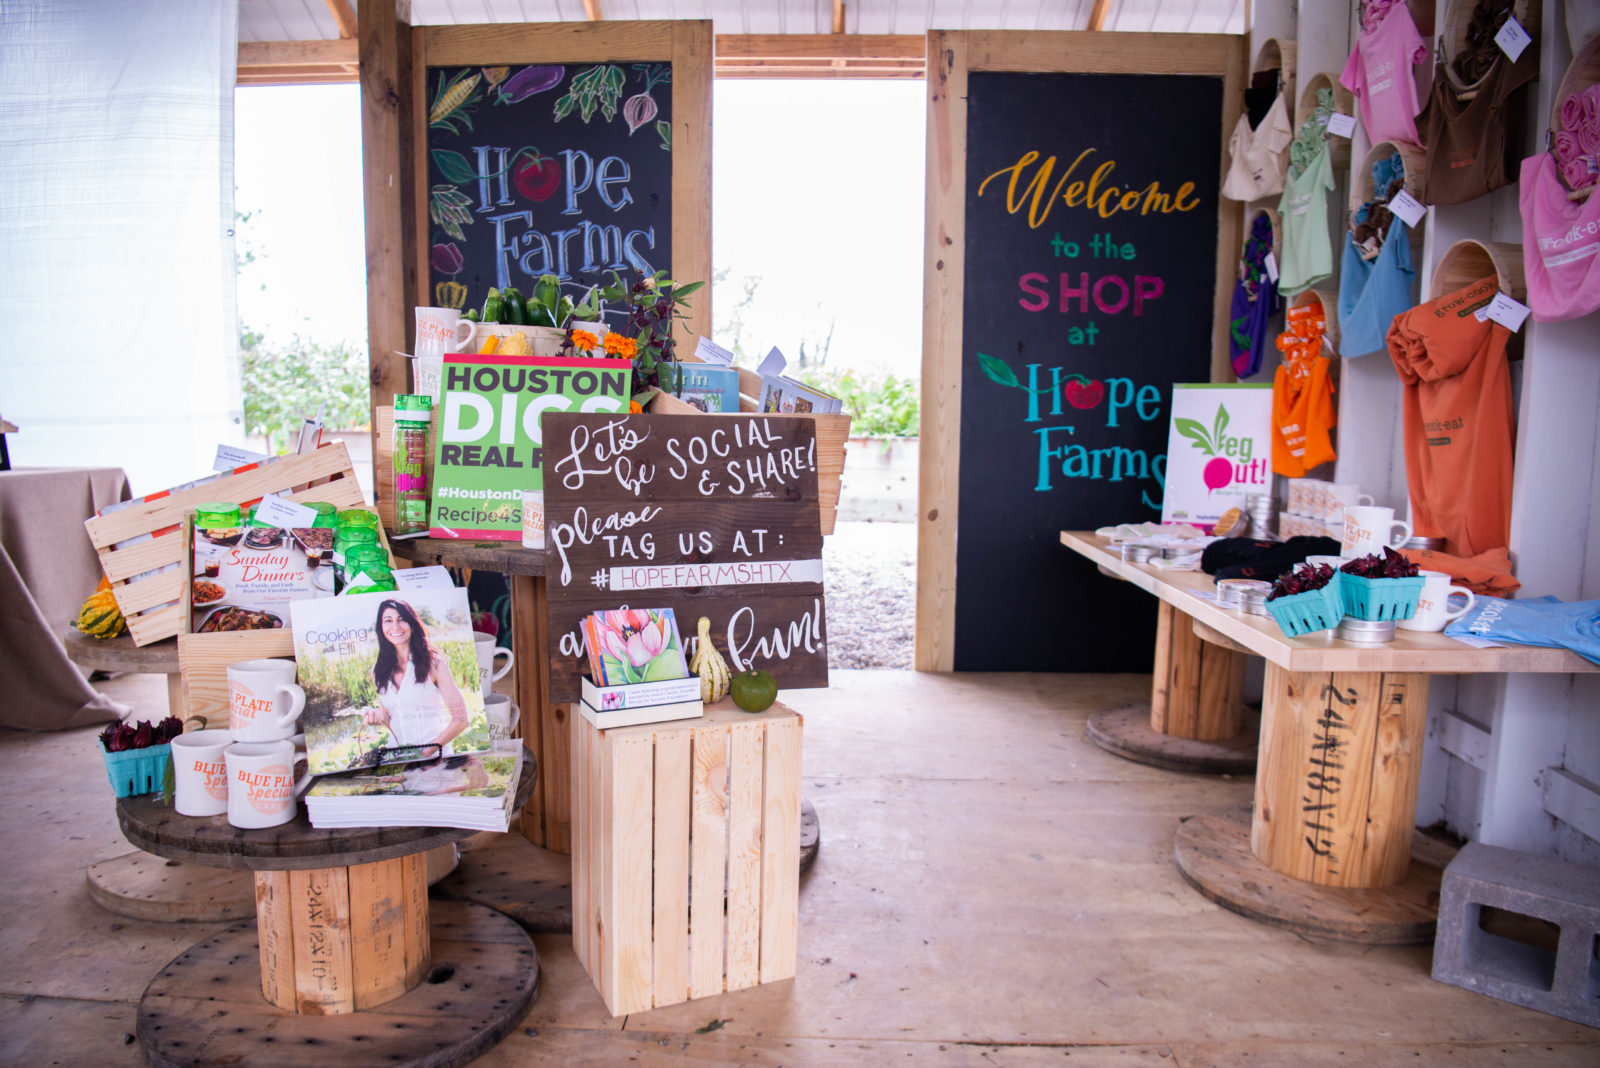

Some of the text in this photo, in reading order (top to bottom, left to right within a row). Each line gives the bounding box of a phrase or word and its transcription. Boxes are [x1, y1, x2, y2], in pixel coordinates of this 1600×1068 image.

[978, 148, 1200, 229] Welcome
[486, 210, 657, 300] Farms
[1051, 233, 1137, 261] to the
[1018, 272, 1165, 317] SHOP
[1067, 321, 1100, 346] at
[447, 366, 626, 396] HOUSTON
[440, 444, 524, 469] REAL
[555, 414, 782, 490] Let's SOCIAL
[614, 437, 816, 496] be & SHARE!
[437, 487, 524, 501] #HoustonD
[437, 506, 522, 524] Recipe4S
[551, 506, 663, 587] please
[602, 533, 656, 560] TAG
[678, 531, 713, 555] US
[226, 549, 289, 570] Sunday
[241, 565, 304, 582] Dinners
[590, 561, 793, 591] #HOPEFARMSHTX
[305, 626, 368, 645] Cooking
[727, 598, 823, 673] fun!
[339, 641, 356, 656] Elli
[235, 693, 273, 713] PLATE
[193, 761, 226, 776] BLUE
[237, 770, 270, 788] BLUE
[273, 776, 294, 789] PLA
[247, 782, 293, 801] Special
